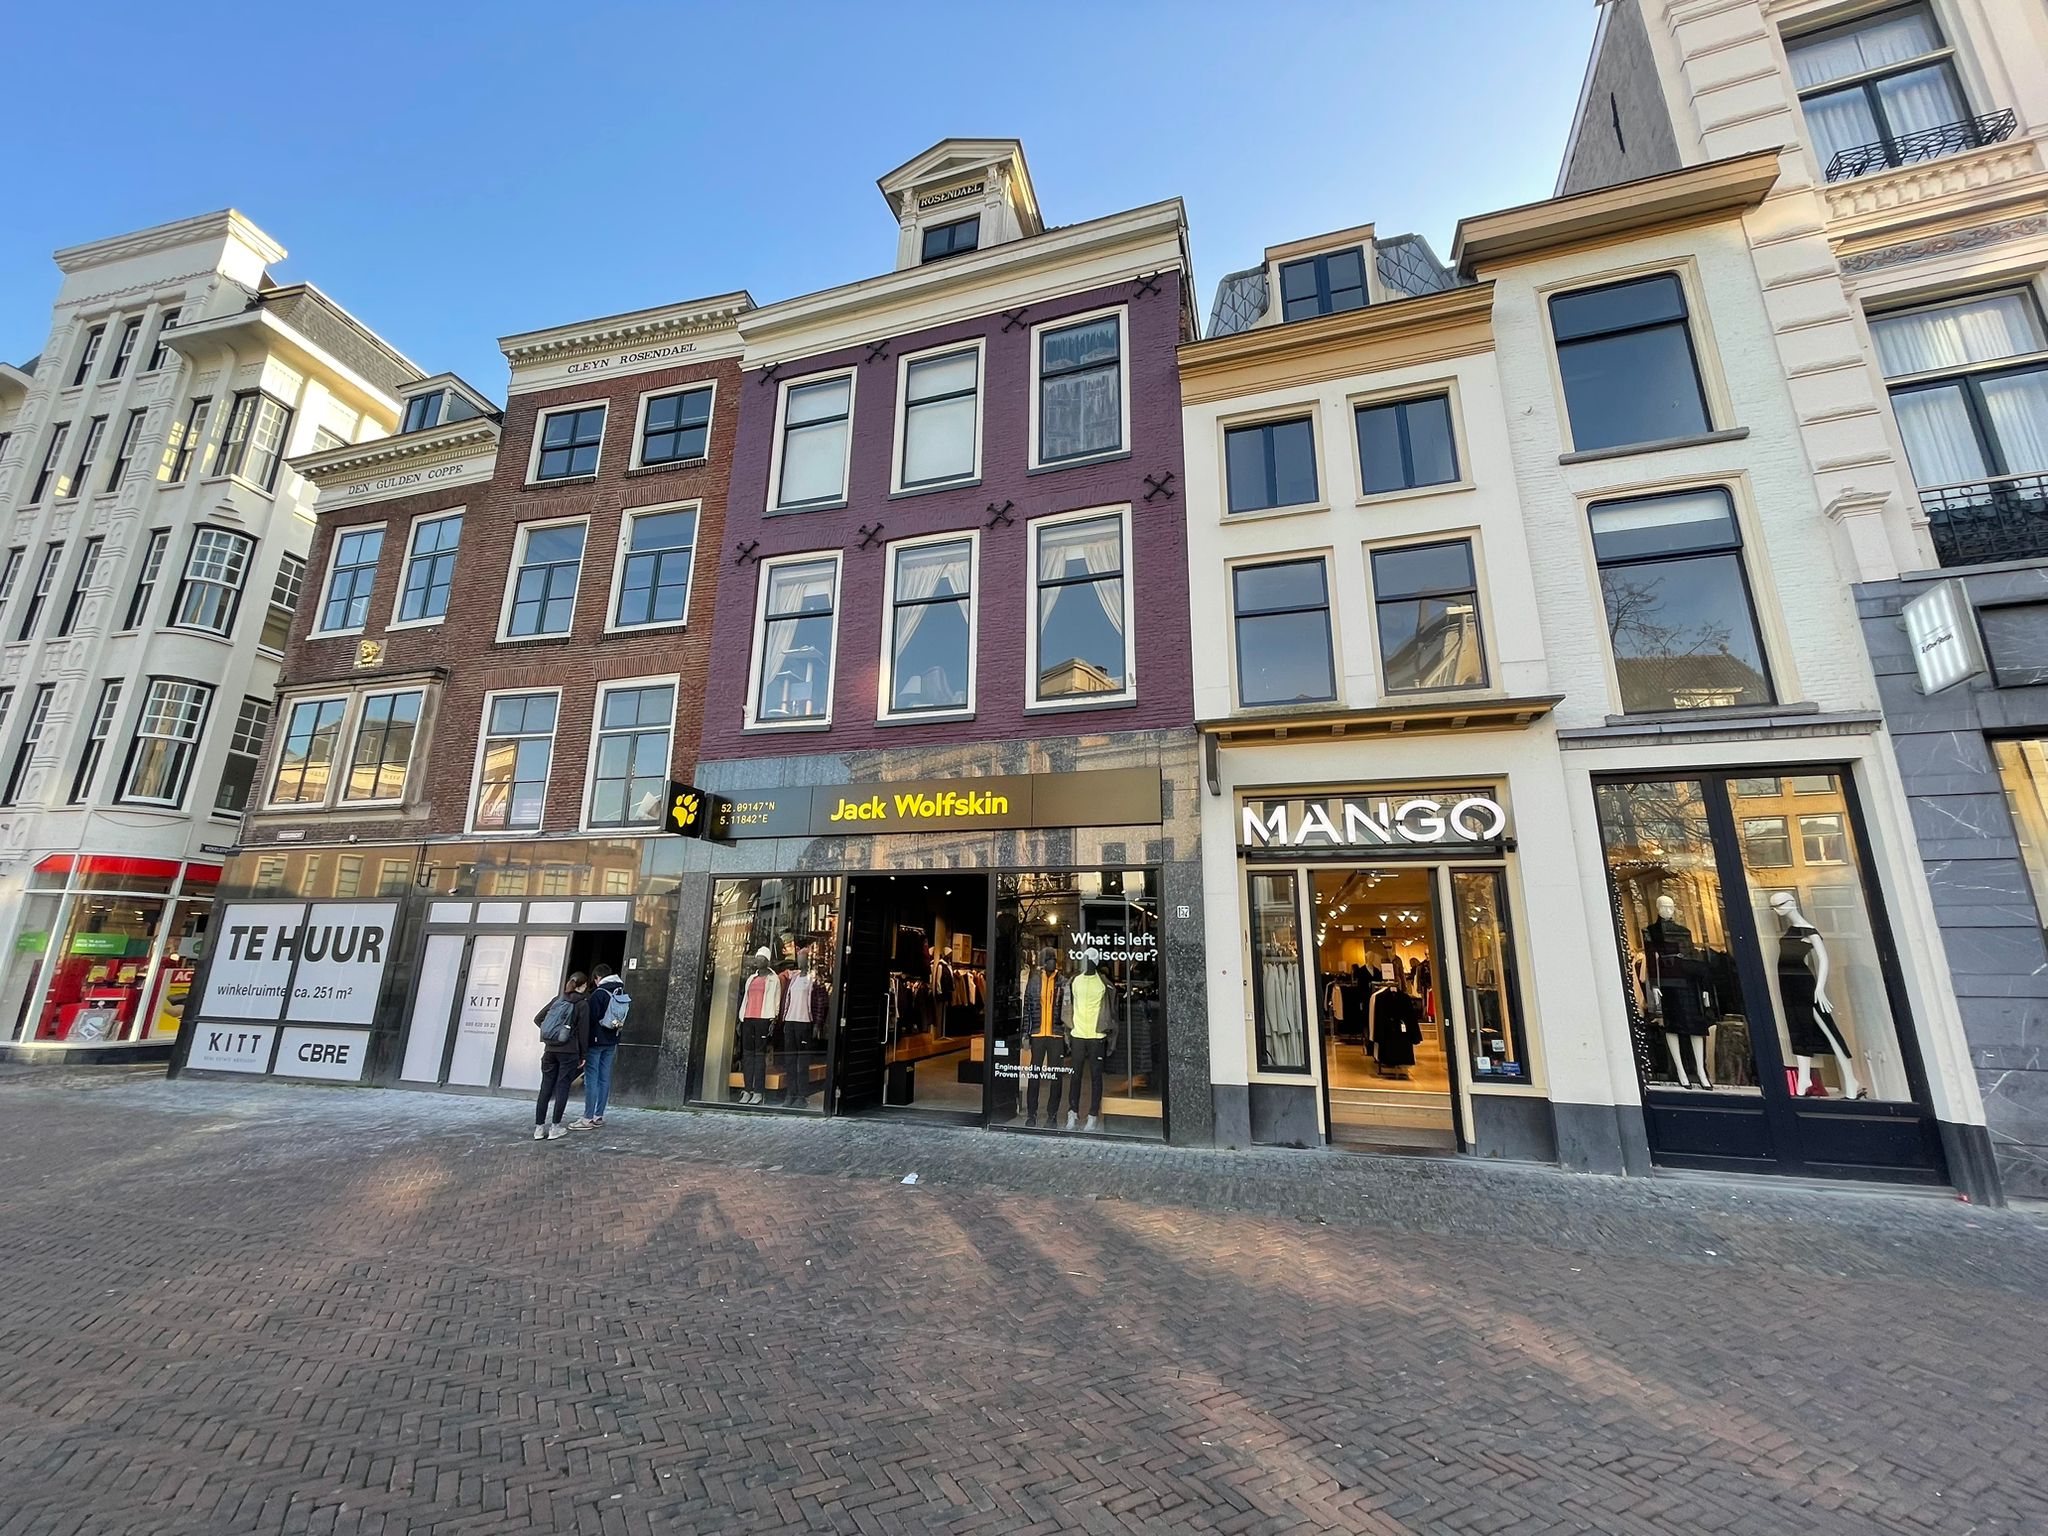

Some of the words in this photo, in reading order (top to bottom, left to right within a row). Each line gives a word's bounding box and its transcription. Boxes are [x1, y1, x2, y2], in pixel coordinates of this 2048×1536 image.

[920, 184, 981, 207] ROSENDAEL
[567, 358, 610, 374] CLEYN
[619, 343, 697, 364] ROSENDAEL
[348, 483, 370, 495] DEN
[376, 473, 421, 489] GULDEN
[428, 464, 464, 479] COPPE
[830, 796, 888, 821] Jack
[894, 791, 1008, 818] Wolfskin
[1242, 797, 1506, 846] MANGO
[229, 926, 268, 961] TE
[272, 926, 384, 963] HUUR
[1071, 932, 1110, 945] What
[1114, 933, 1125, 945] is
[1129, 933, 1156, 946] left
[1069, 949, 1084, 960] to
[217, 984, 287, 997] winkelruimte
[294, 988, 310, 999] ca.
[313, 987, 333, 999] 251
[471, 996, 501, 1007] KITT
[208, 1032, 261, 1054] KITT
[298, 1043, 350, 1064] CBRE
[994, 1062, 1033, 1071] Engineered
[1041, 1065, 1075, 1074] Germany,
[994, 1070, 1018, 1078] Proven
